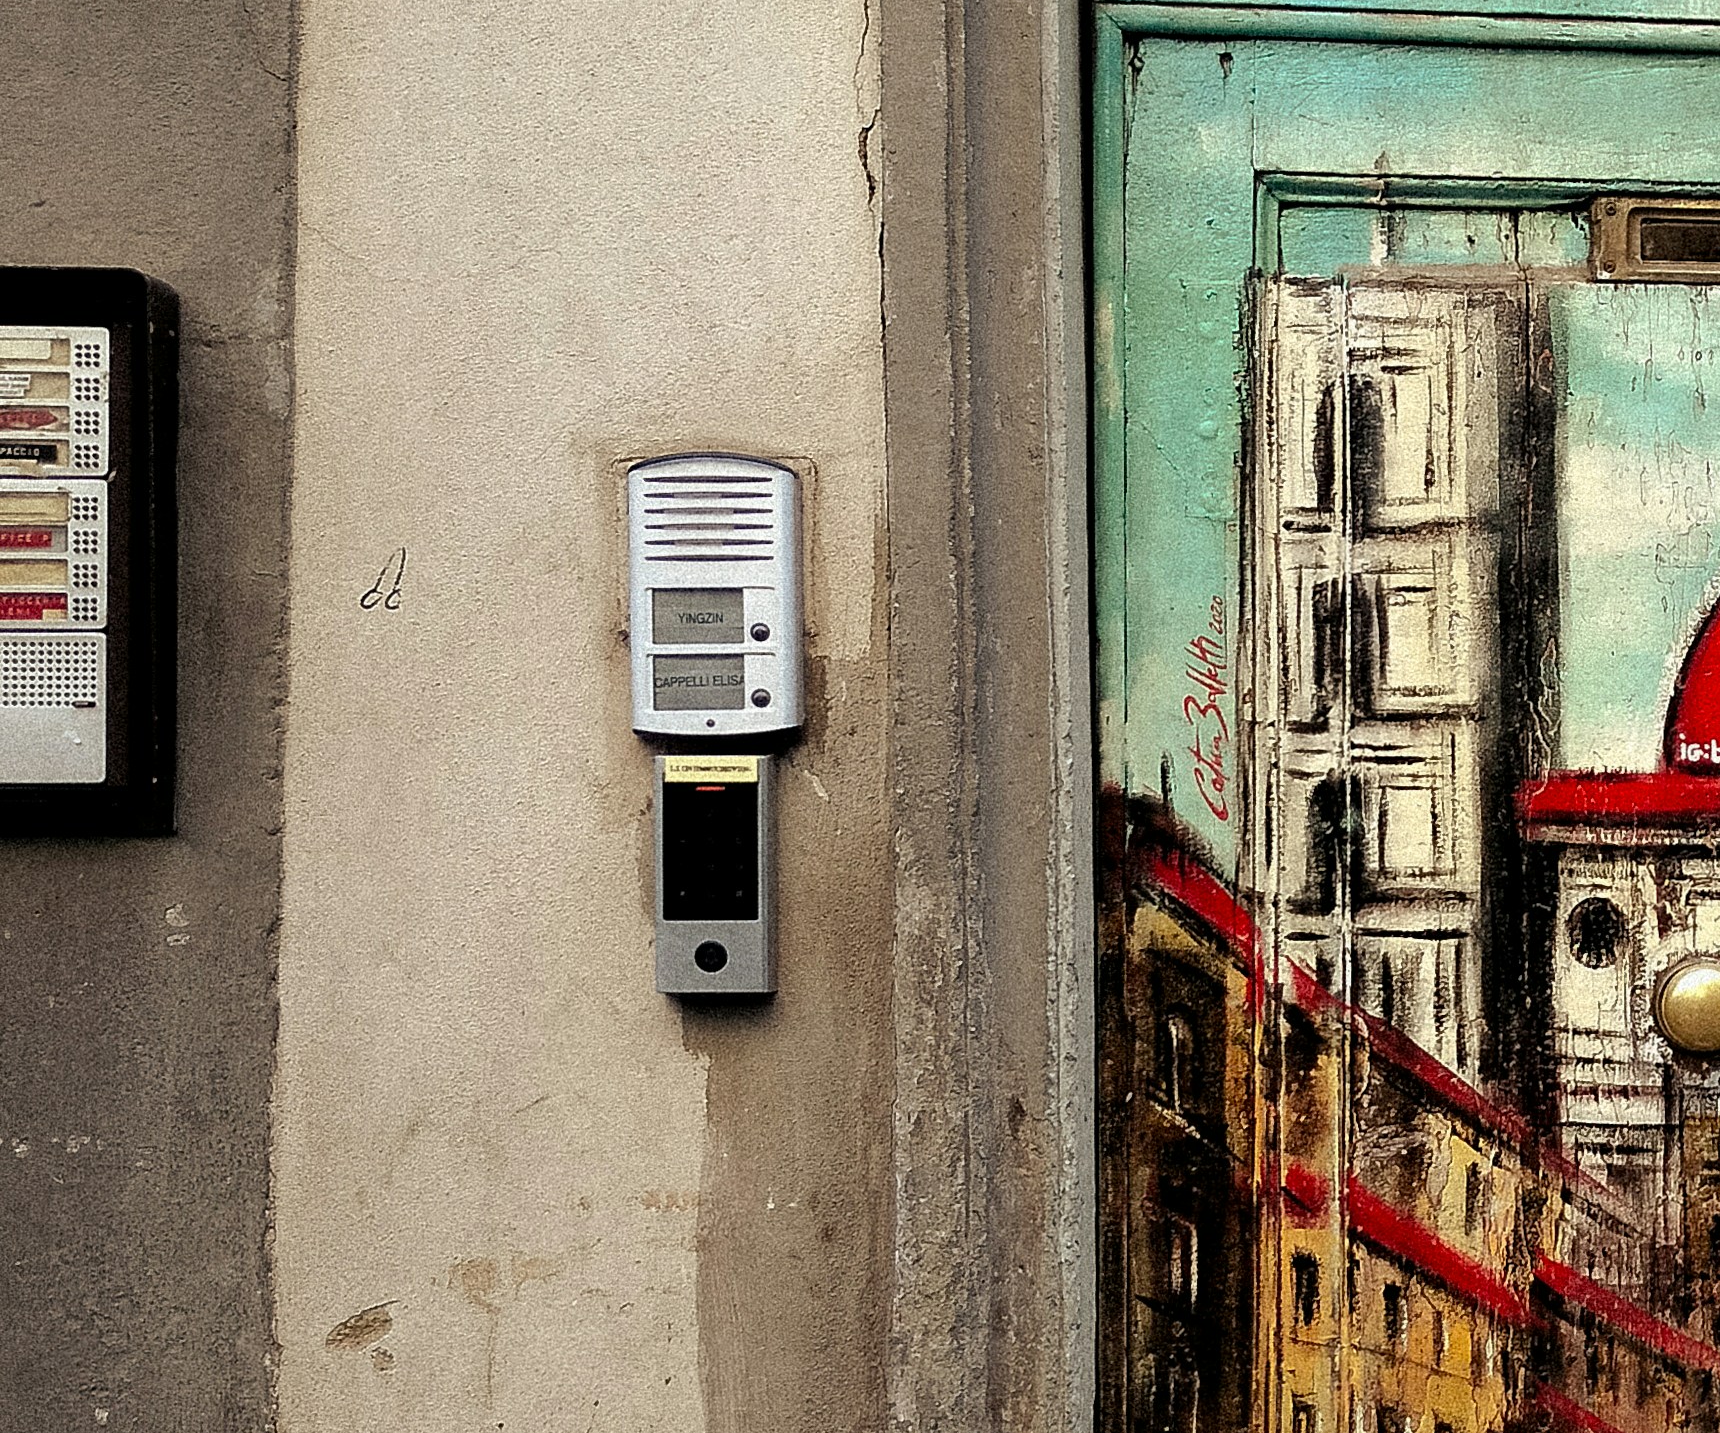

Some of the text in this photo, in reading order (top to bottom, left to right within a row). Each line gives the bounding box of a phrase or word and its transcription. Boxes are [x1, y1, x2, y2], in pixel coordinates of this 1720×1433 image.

[1208, 595, 1224, 635] 2020
[654, 675, 744, 688] CAPPELLI ELISA
